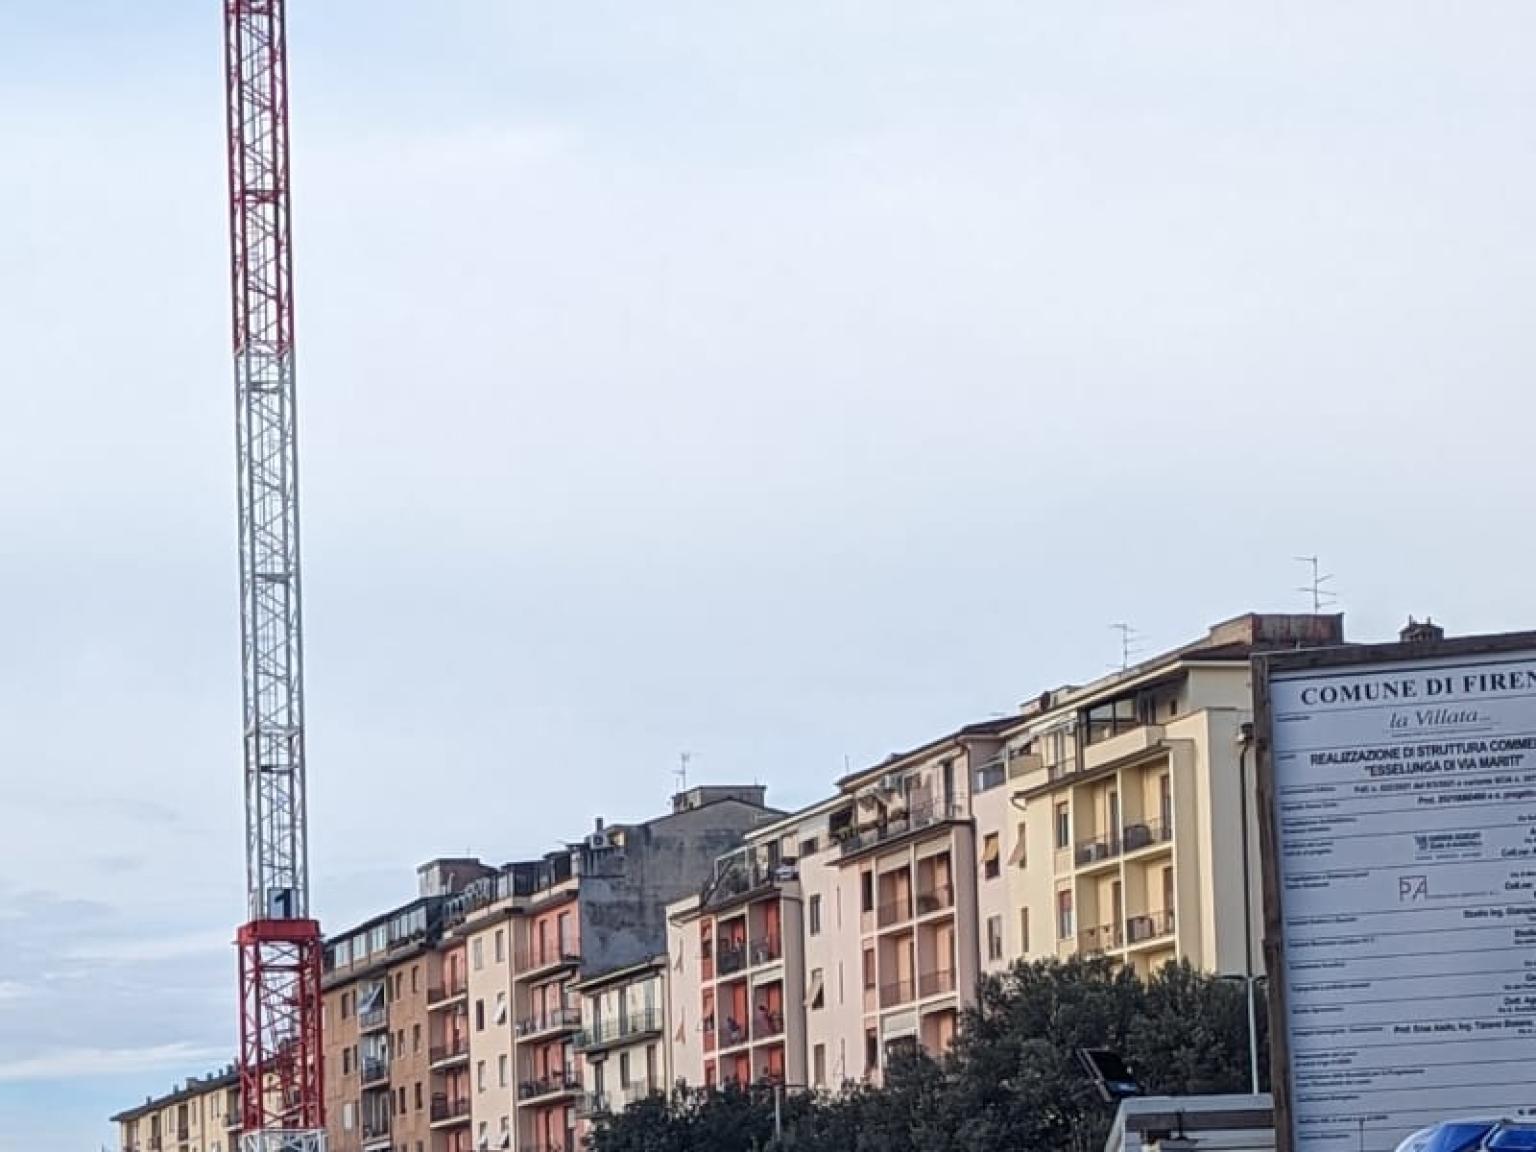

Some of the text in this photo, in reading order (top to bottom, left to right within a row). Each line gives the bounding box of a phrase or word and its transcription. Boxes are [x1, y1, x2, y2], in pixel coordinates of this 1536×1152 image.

[1301, 680, 1417, 705] COMUNE
[1426, 677, 1452, 696] DI
[1389, 711, 1407, 728] la
[1310, 747, 1400, 766] REALIZZAZIONE
[1403, 746, 1414, 757] DI
[1416, 740, 1487, 756] STRUTTURA
[1443, 758, 1456, 771] DI
[1457, 757, 1477, 770] VIA
